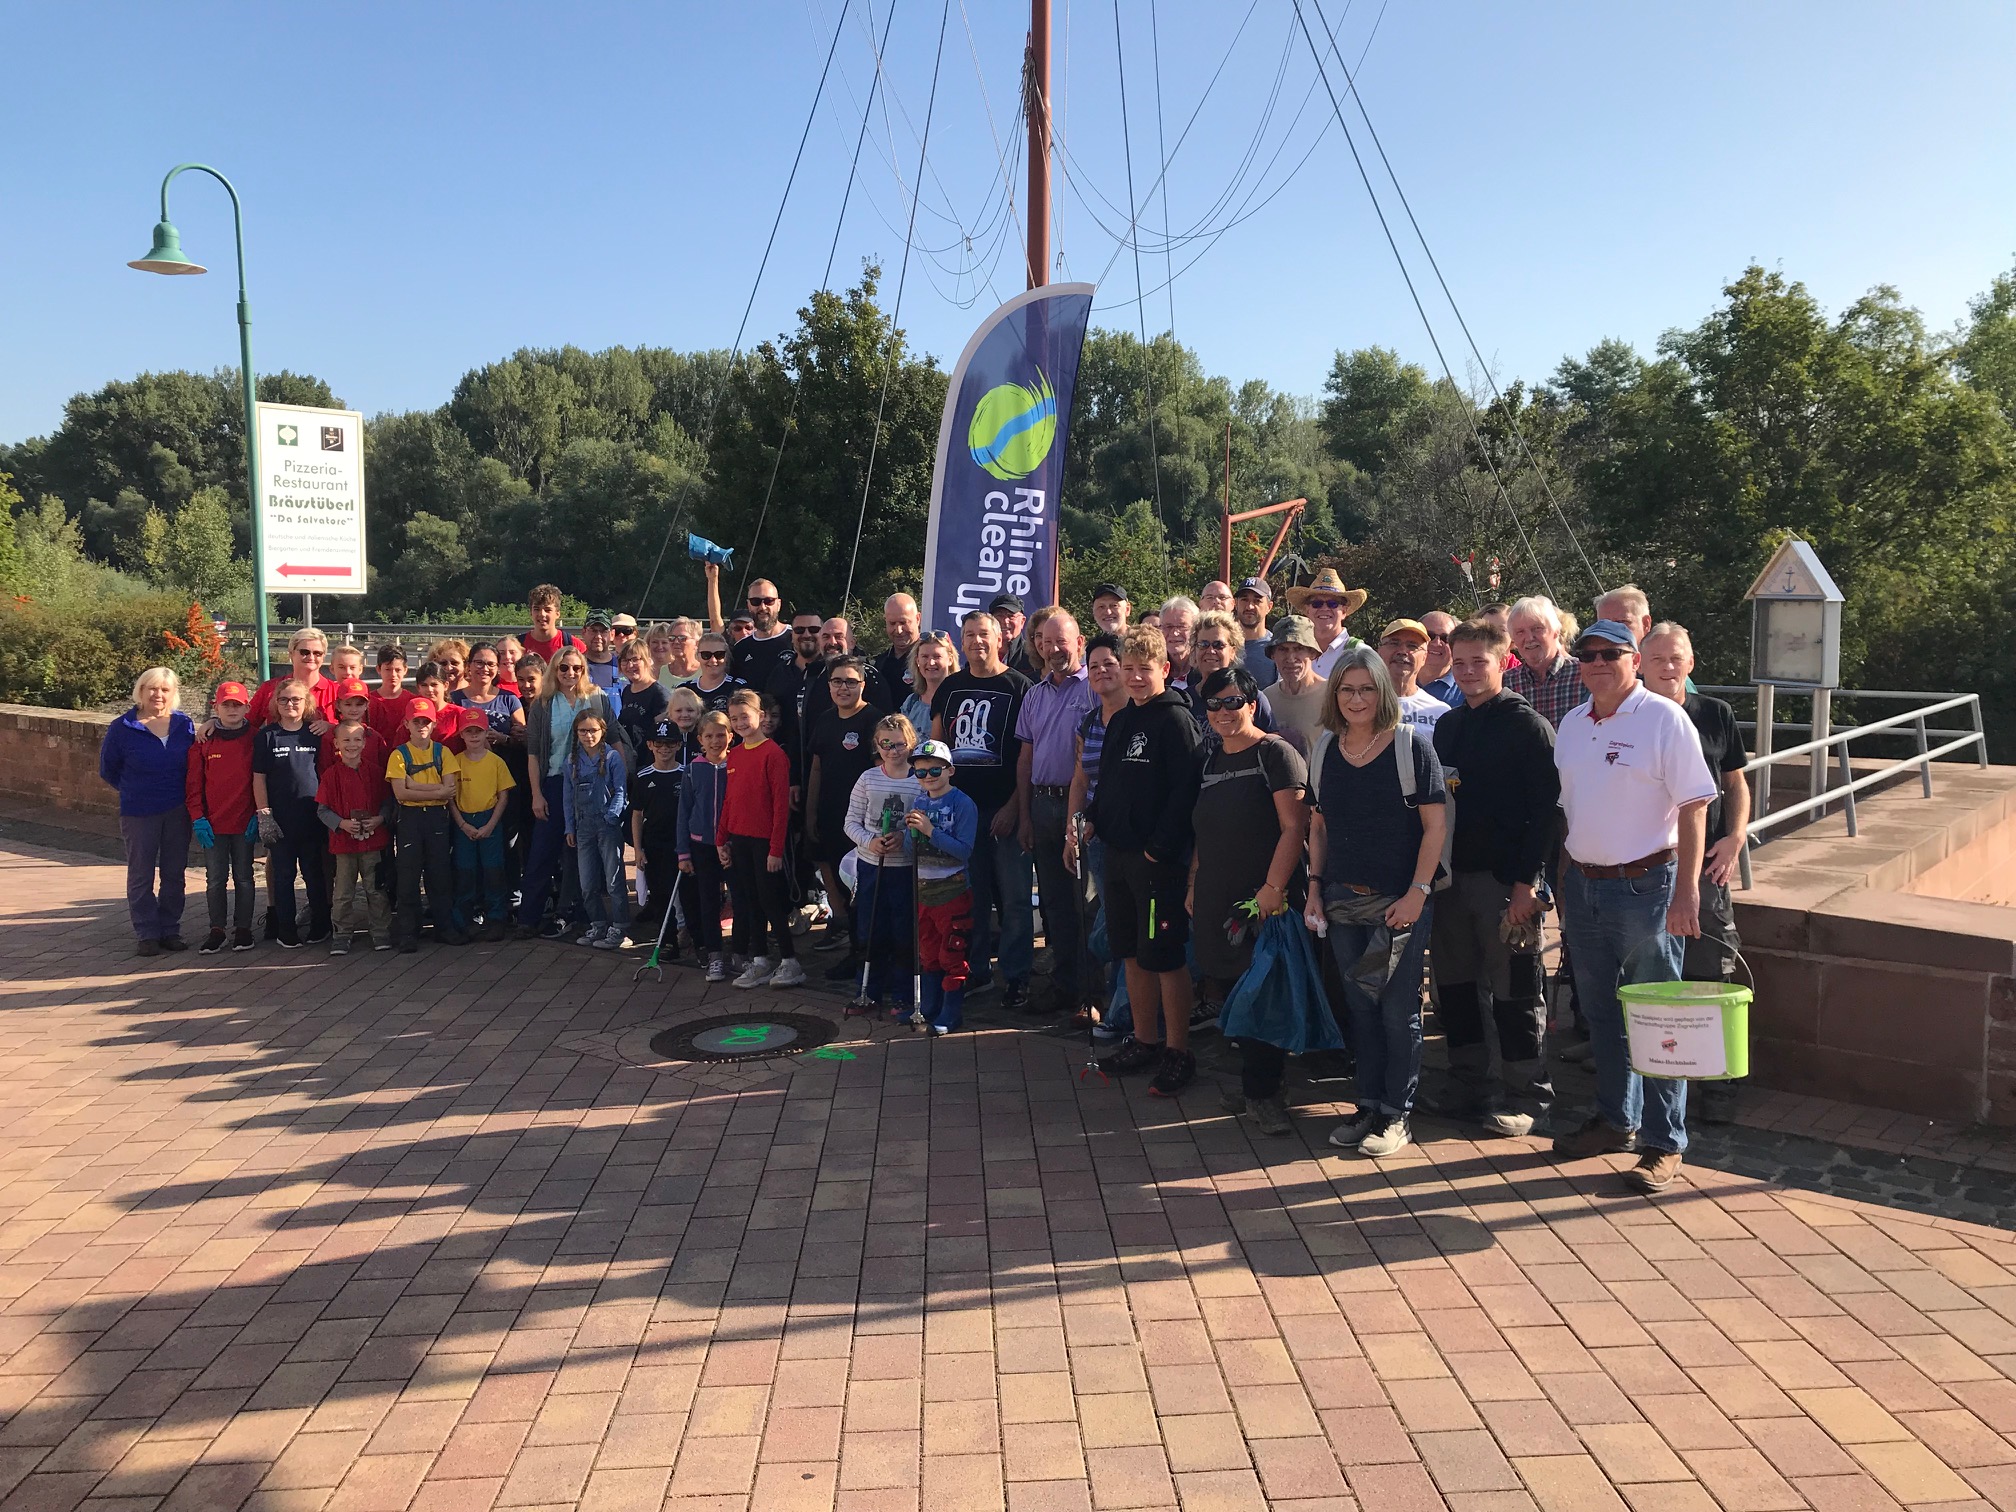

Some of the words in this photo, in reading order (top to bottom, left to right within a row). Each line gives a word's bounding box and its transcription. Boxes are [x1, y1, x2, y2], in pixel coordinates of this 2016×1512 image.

[284, 459, 343, 476] Pizzeria-
[273, 474, 348, 491] Restaurant
[268, 494, 354, 511] Bräustüberl
[1006, 487, 1046, 596] Rhine
[955, 698, 992, 739] 60
[1402, 711, 1438, 726] plat
[954, 736, 987, 750] NASA
